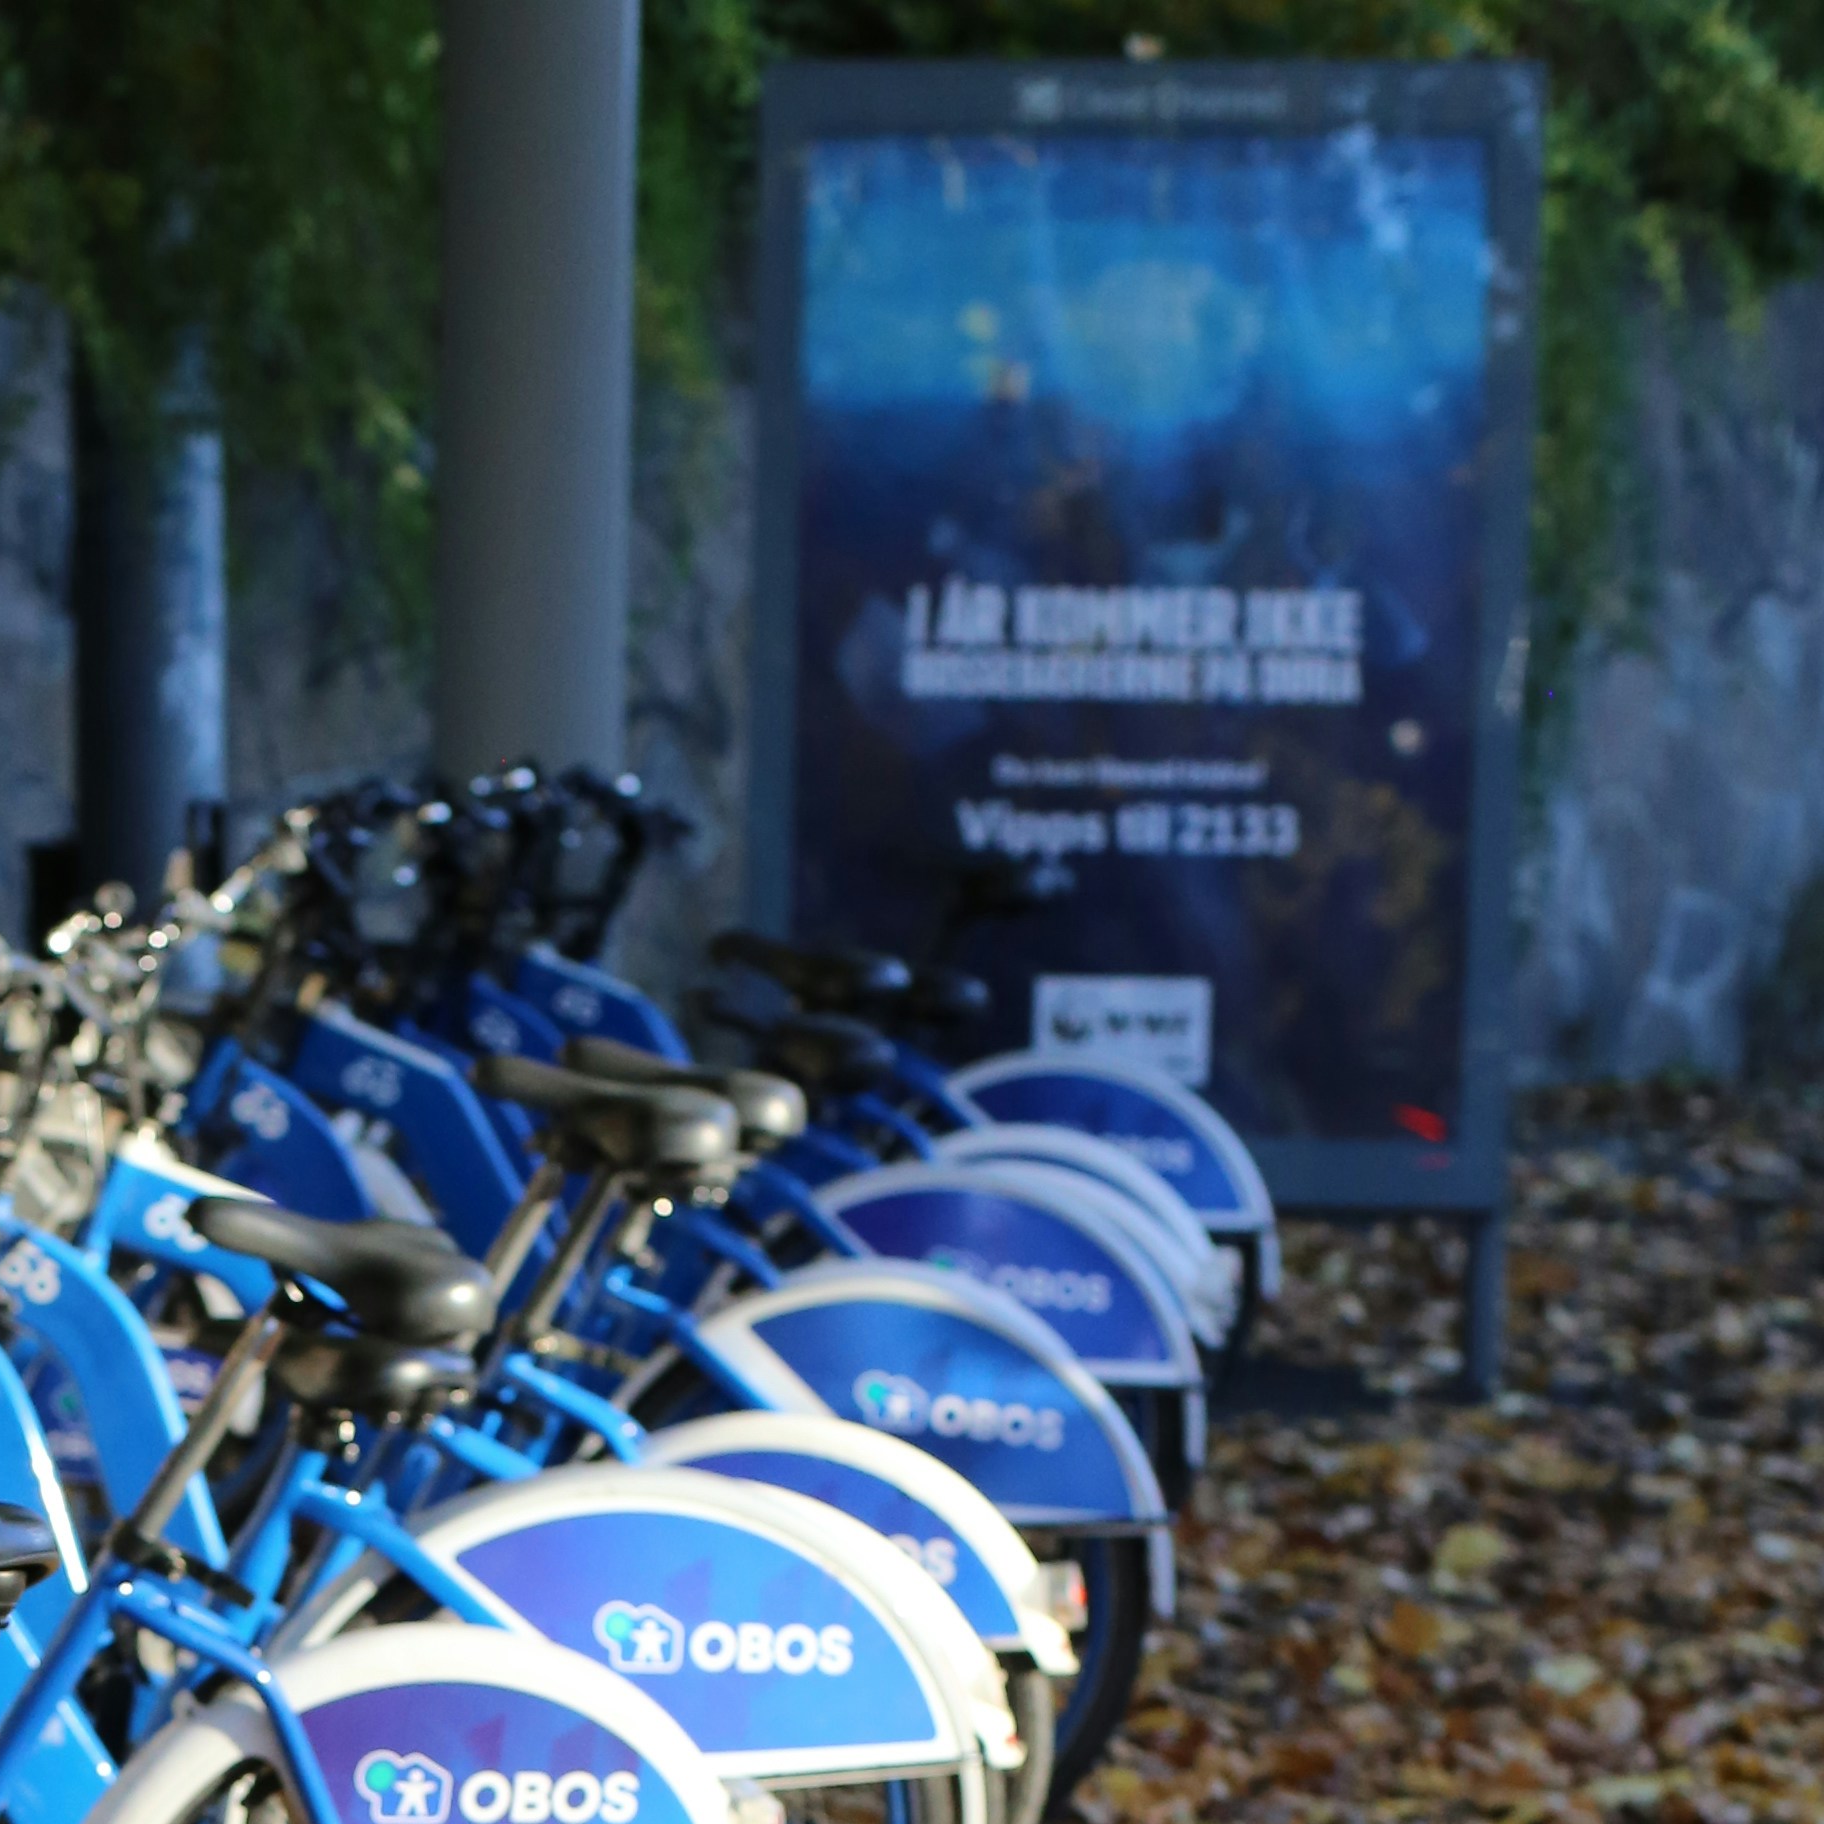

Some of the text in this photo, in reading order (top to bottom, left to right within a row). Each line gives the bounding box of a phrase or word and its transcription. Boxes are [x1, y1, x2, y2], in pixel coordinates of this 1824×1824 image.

[1176, 804, 1300, 857] 2133
[930, 1393, 1066, 1451] OBOS
[689, 1620, 854, 1676] OBOS
